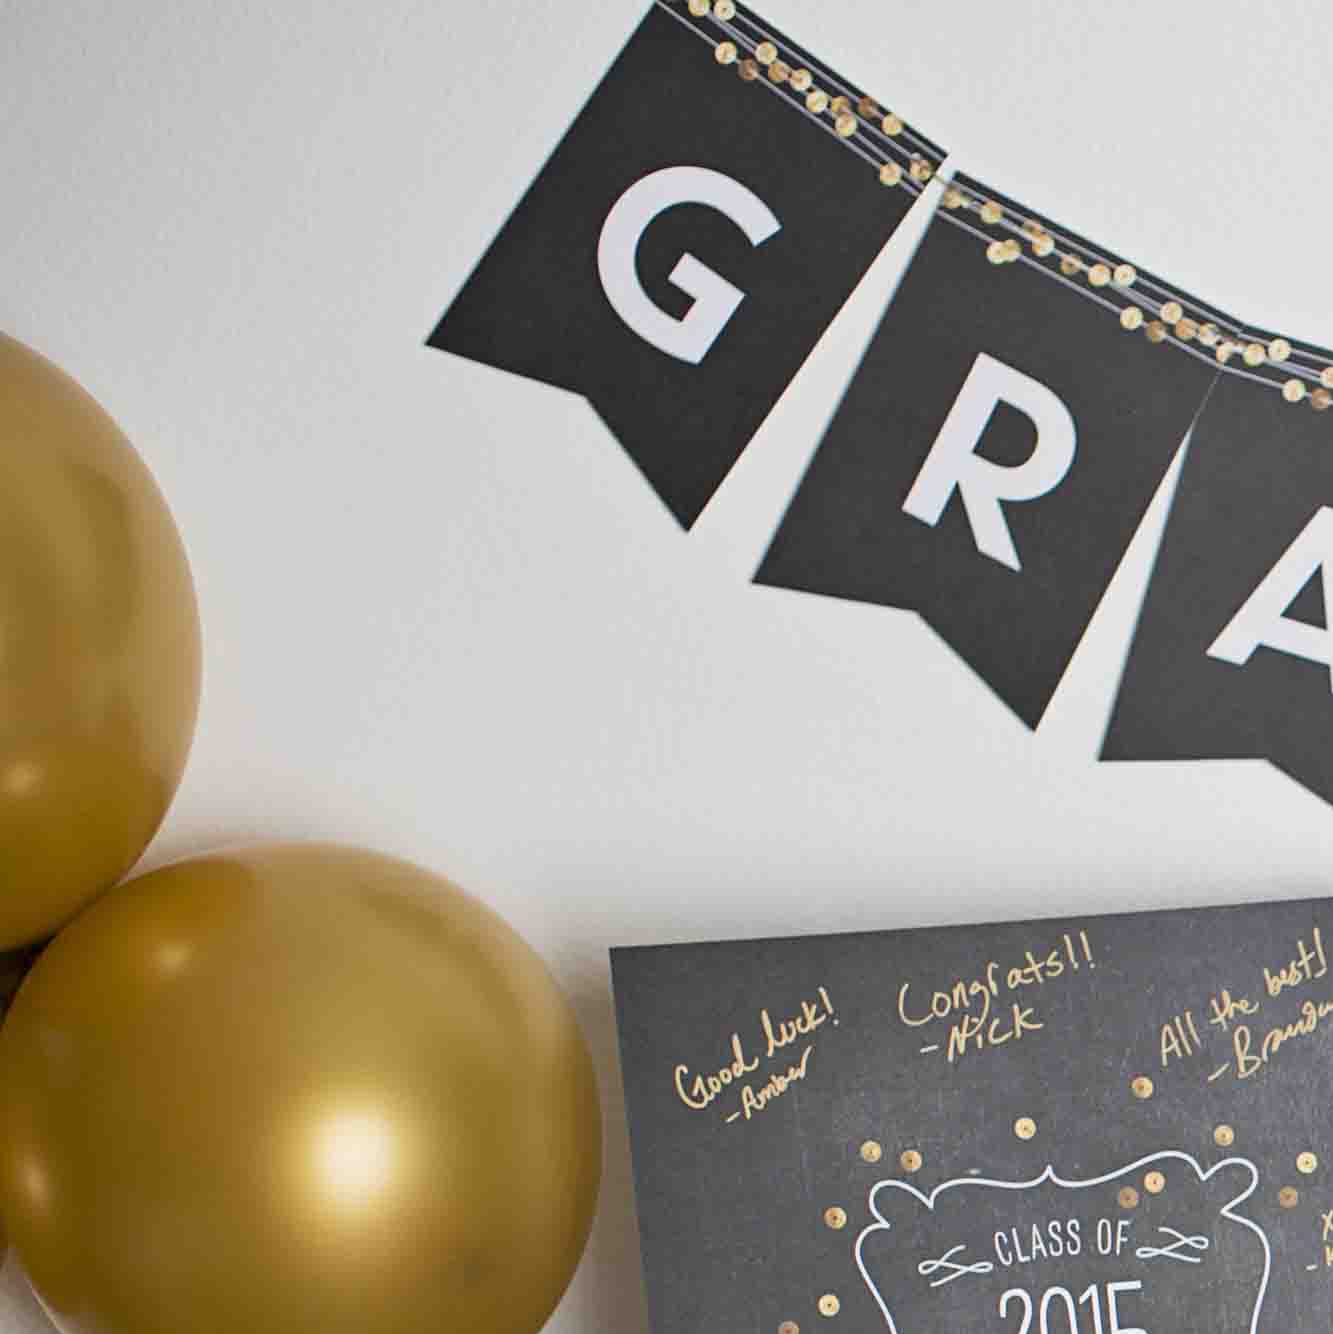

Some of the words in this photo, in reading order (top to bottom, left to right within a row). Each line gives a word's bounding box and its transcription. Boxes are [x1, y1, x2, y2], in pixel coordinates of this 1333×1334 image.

[1159, 1010, 1201, 1067] All
[1209, 990, 1259, 1032] the
[675, 1033, 758, 1109] Good
[994, 1219, 1081, 1266] CLASS
[1097, 1218, 1131, 1256] OF
